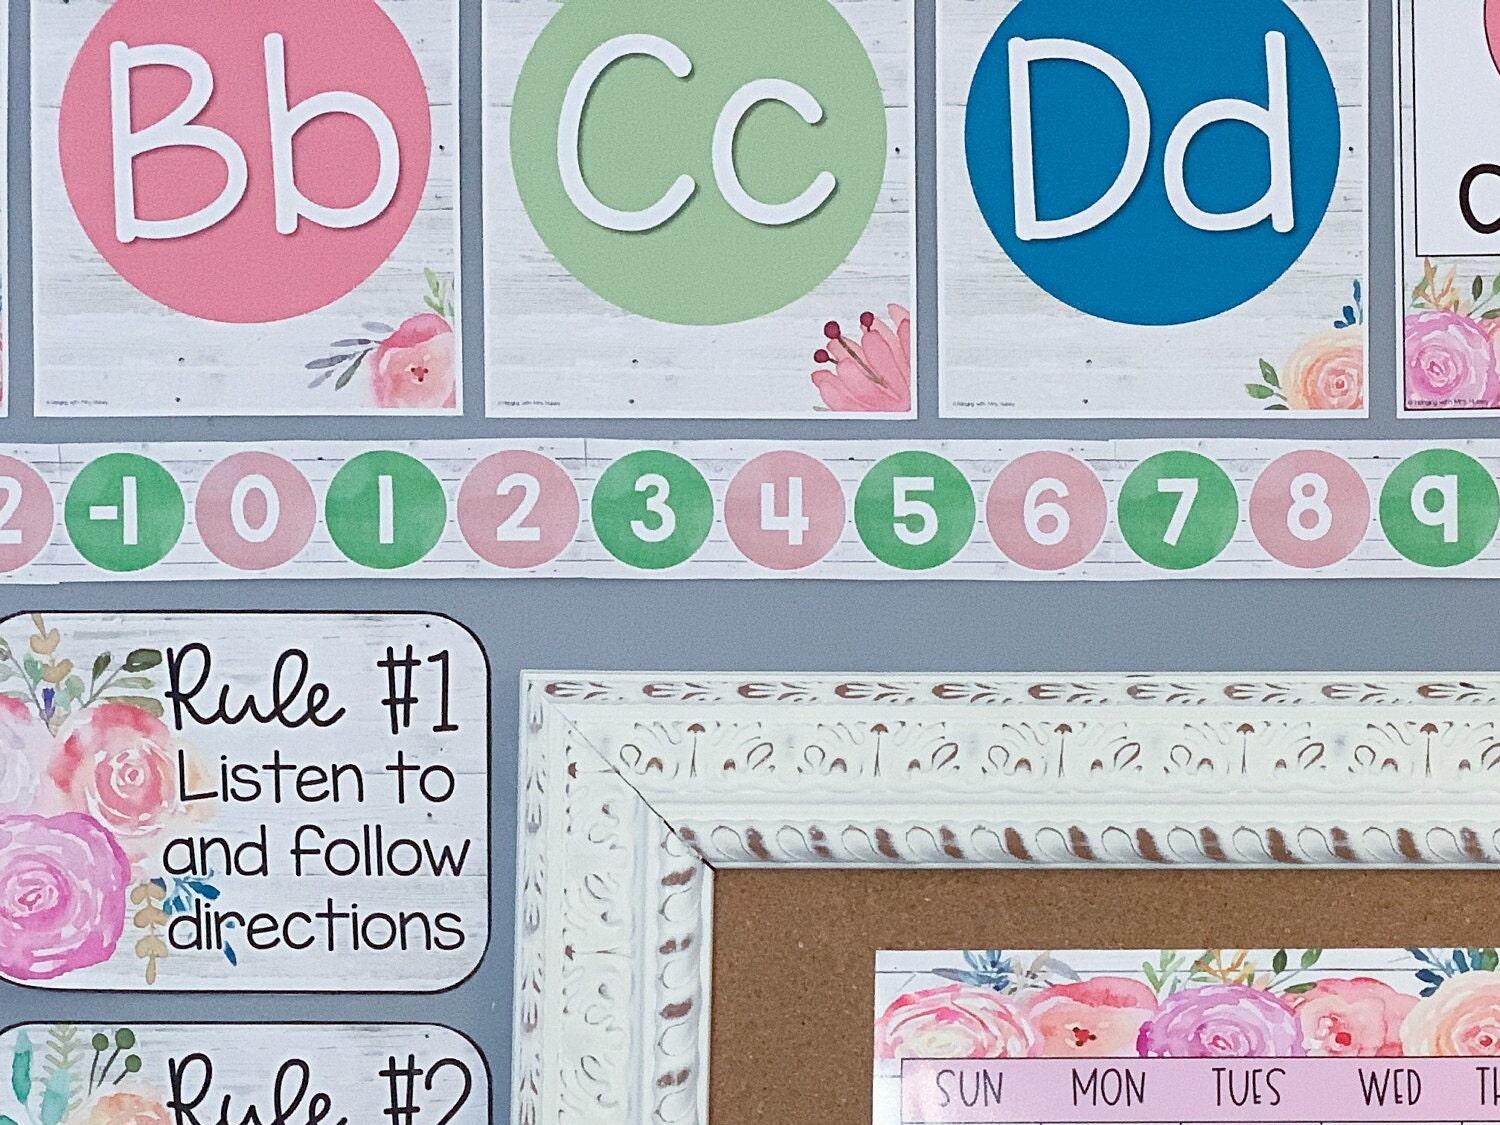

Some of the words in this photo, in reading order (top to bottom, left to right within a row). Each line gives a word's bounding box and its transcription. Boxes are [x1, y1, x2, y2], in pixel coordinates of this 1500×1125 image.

[109, 32, 401, 243] Bb
[557, 33, 837, 231] Cc
[1007, 30, 1294, 241] Dd
[88, 475, 138, 545] -1
[231, 473, 281, 543] 0
[376, 475, 394, 544] 1
[496, 473, 541, 541] 2
[629, 474, 676, 541] 3
[761, 477, 809, 545] 4
[893, 477, 938, 545] 5
[1022, 477, 1070, 544] 6
[1157, 478, 1198, 546] 7
[1286, 473, 1332, 540] 8
[1410, 474, 1458, 541] 9
[165, 643, 346, 730] Rule
[377, 644, 459, 734] #1
[179, 750, 364, 803] Listen
[386, 751, 455, 803] to
[163, 825, 267, 876] and
[291, 825, 470, 876] follow
[168, 899, 465, 951] directions
[936, 1070, 1003, 1108] SUN
[1072, 1069, 1146, 1106] MON
[1212, 1068, 1286, 1107] TUES
[1358, 1068, 1422, 1106] WED
